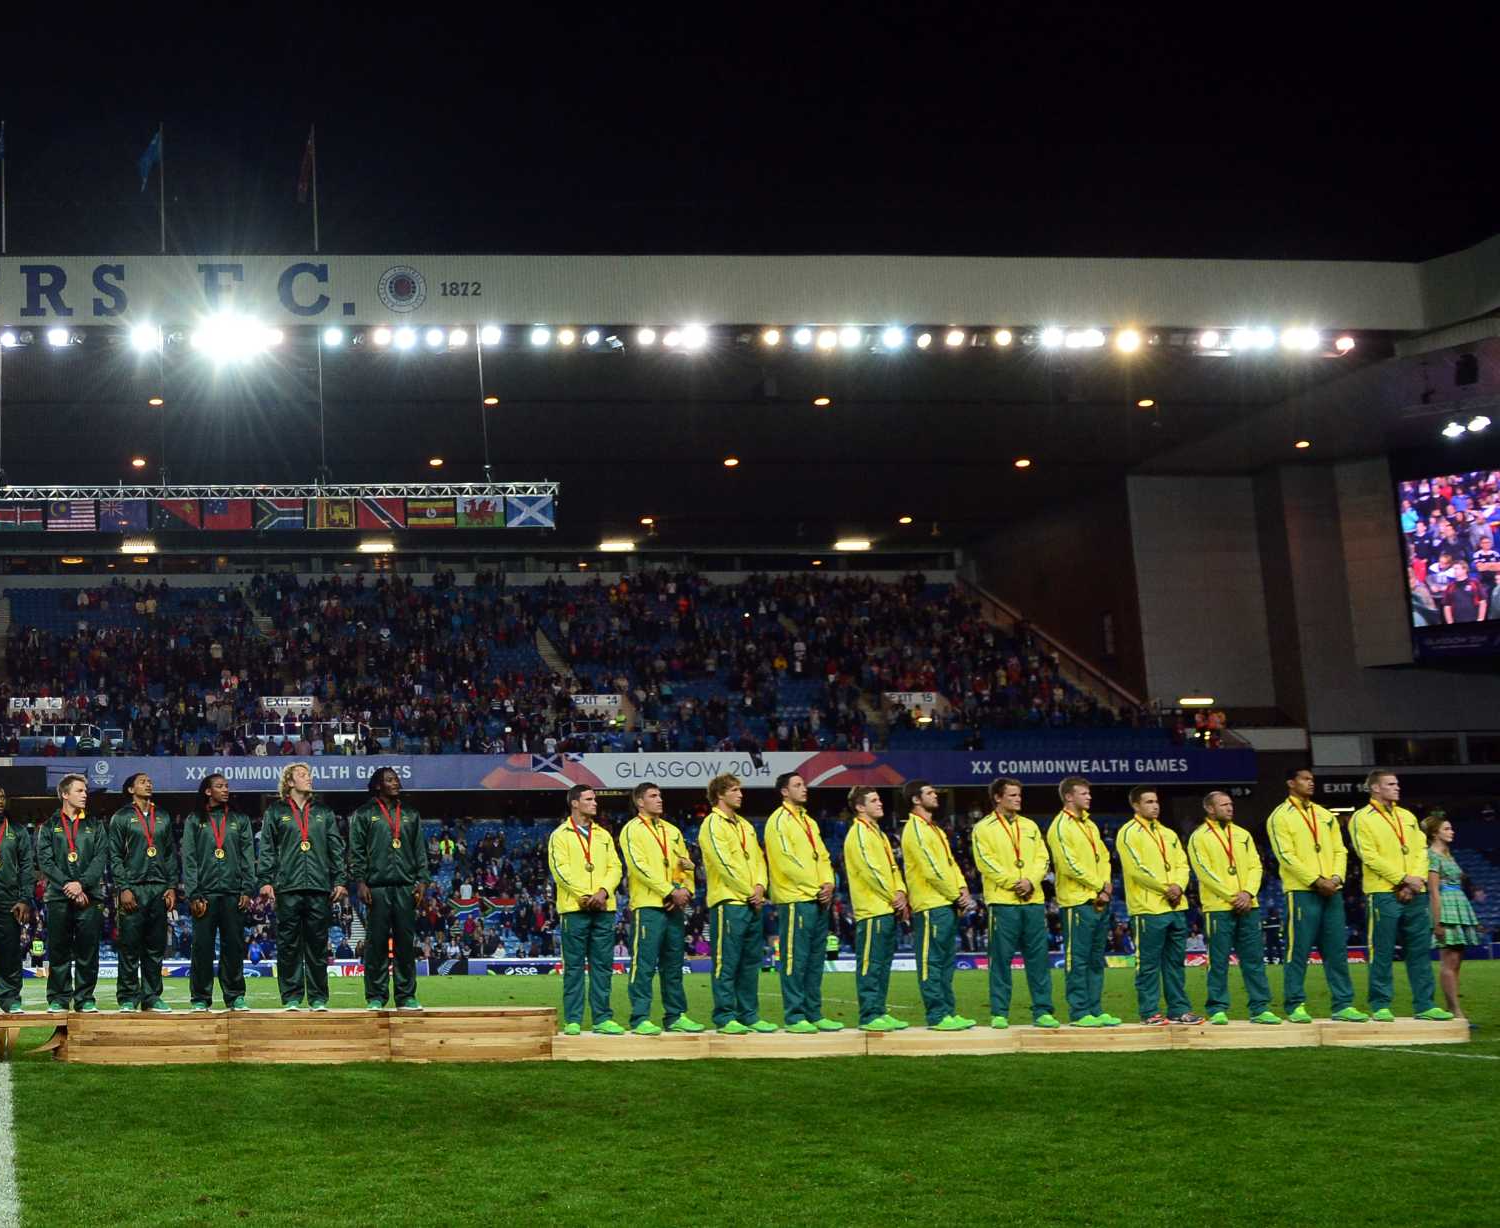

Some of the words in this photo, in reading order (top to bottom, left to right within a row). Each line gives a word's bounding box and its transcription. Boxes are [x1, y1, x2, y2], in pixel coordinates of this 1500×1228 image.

[440, 282, 482, 296] 1872
[266, 697, 290, 707] EXIT
[575, 696, 598, 705] EXIT
[185, 767, 207, 780] XX
[356, 765, 412, 779] GAES
[615, 761, 721, 777] GLASGOW
[972, 761, 993, 774] XX
[998, 760, 1130, 774] COMMONWEALTH
[1135, 759, 1189, 772] GAMES
[1323, 783, 1352, 793] EXIT
[515, 966, 539, 976] sse
